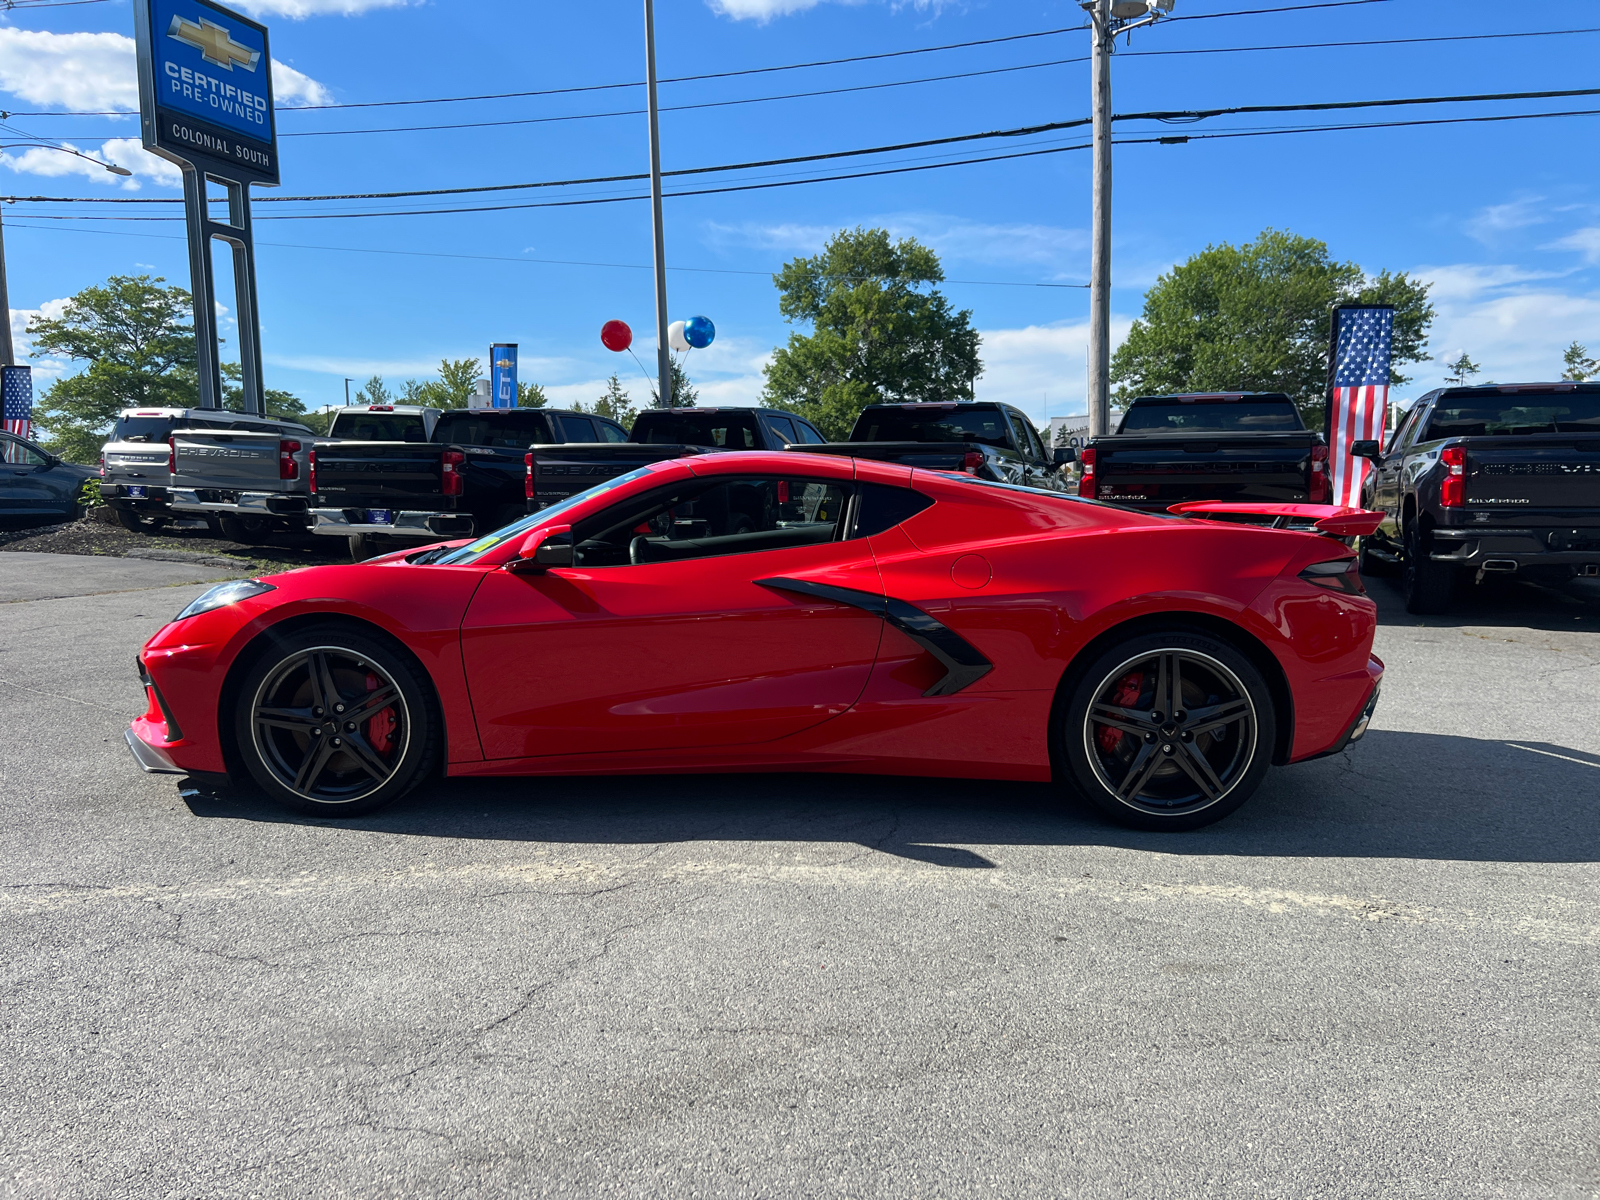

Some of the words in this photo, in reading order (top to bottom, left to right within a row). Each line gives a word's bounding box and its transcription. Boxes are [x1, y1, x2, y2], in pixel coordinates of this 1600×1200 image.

[164, 60, 267, 112] CERTIFIED
[171, 79, 264, 125] PRE-OWNED
[172, 123, 230, 154] COLONIAL
[236, 144, 270, 167] SOUTH
